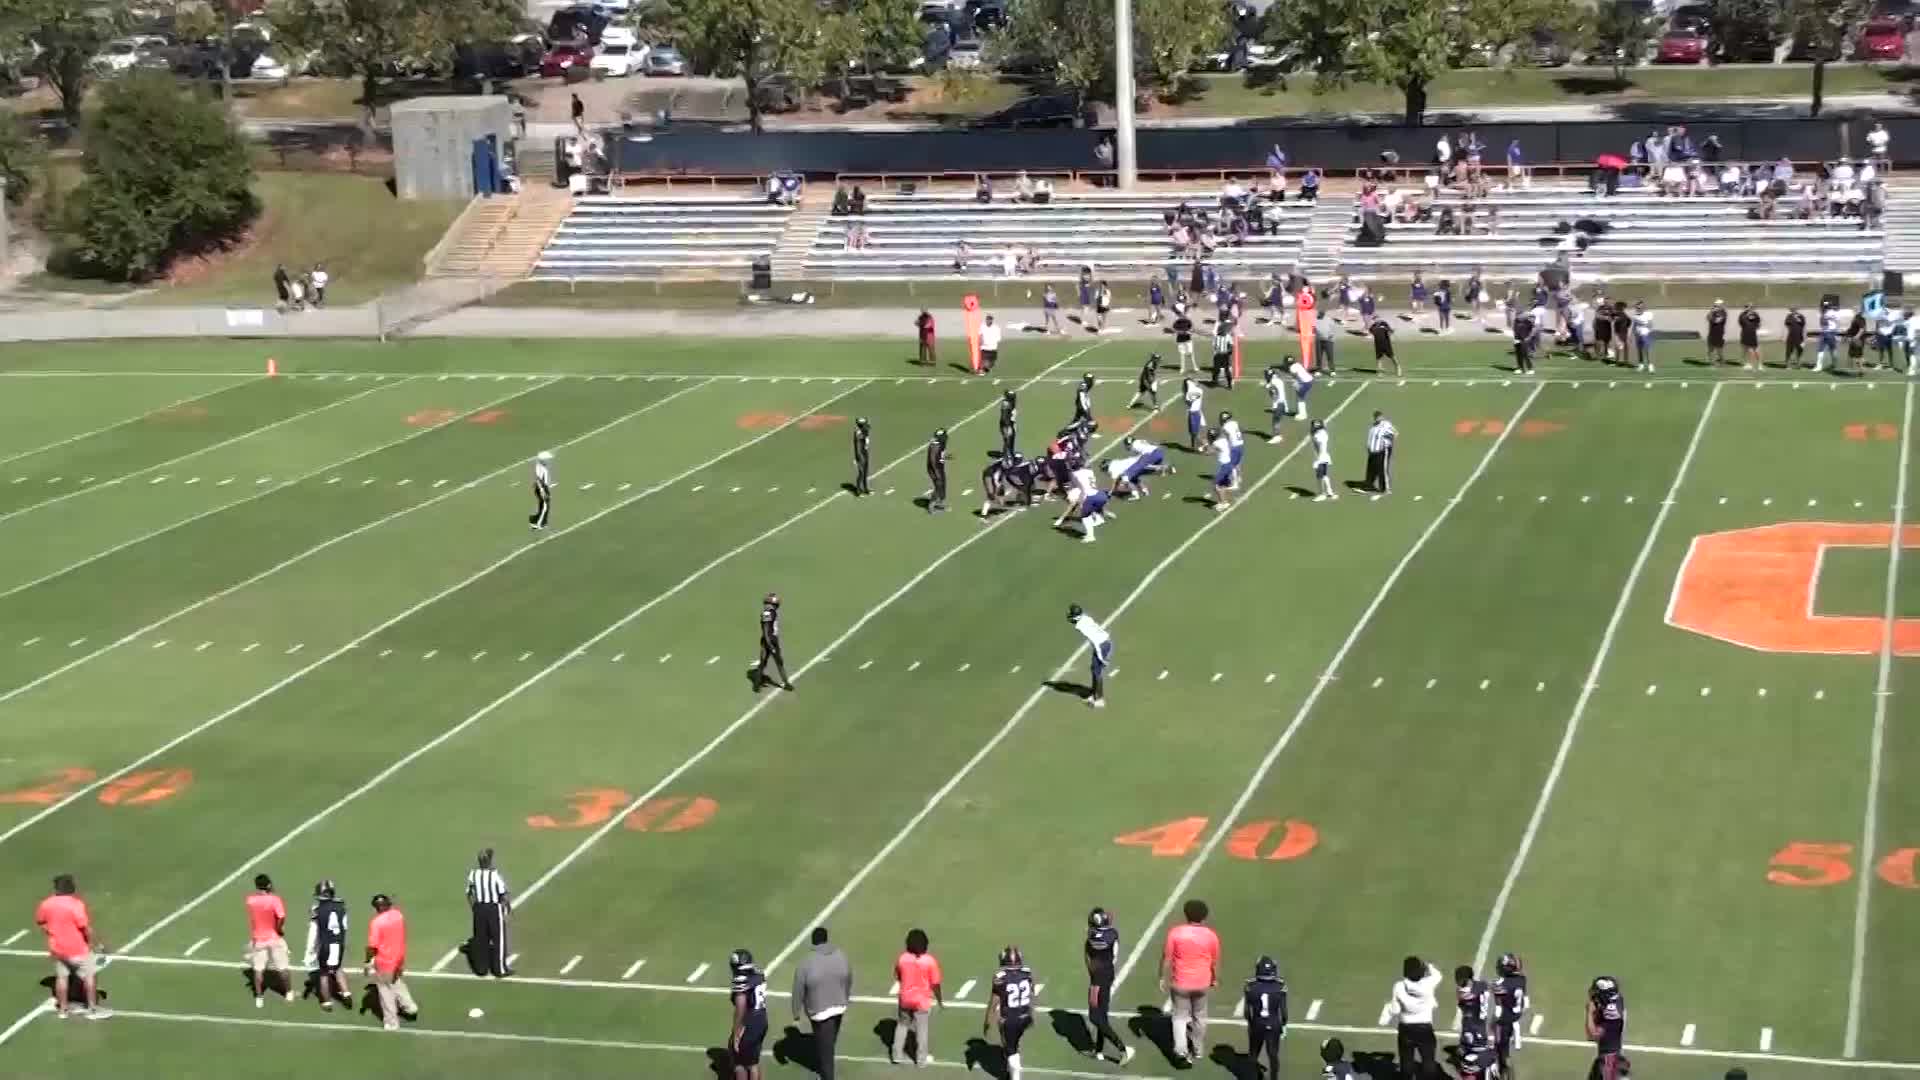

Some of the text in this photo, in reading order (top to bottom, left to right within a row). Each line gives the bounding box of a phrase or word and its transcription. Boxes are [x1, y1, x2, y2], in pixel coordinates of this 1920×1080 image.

[0, 767, 193, 805] 20
[526, 787, 720, 831] 30
[1113, 816, 1319, 860] 40
[1006, 979, 1031, 1008] 22
[1260, 993, 1269, 1017] 1
